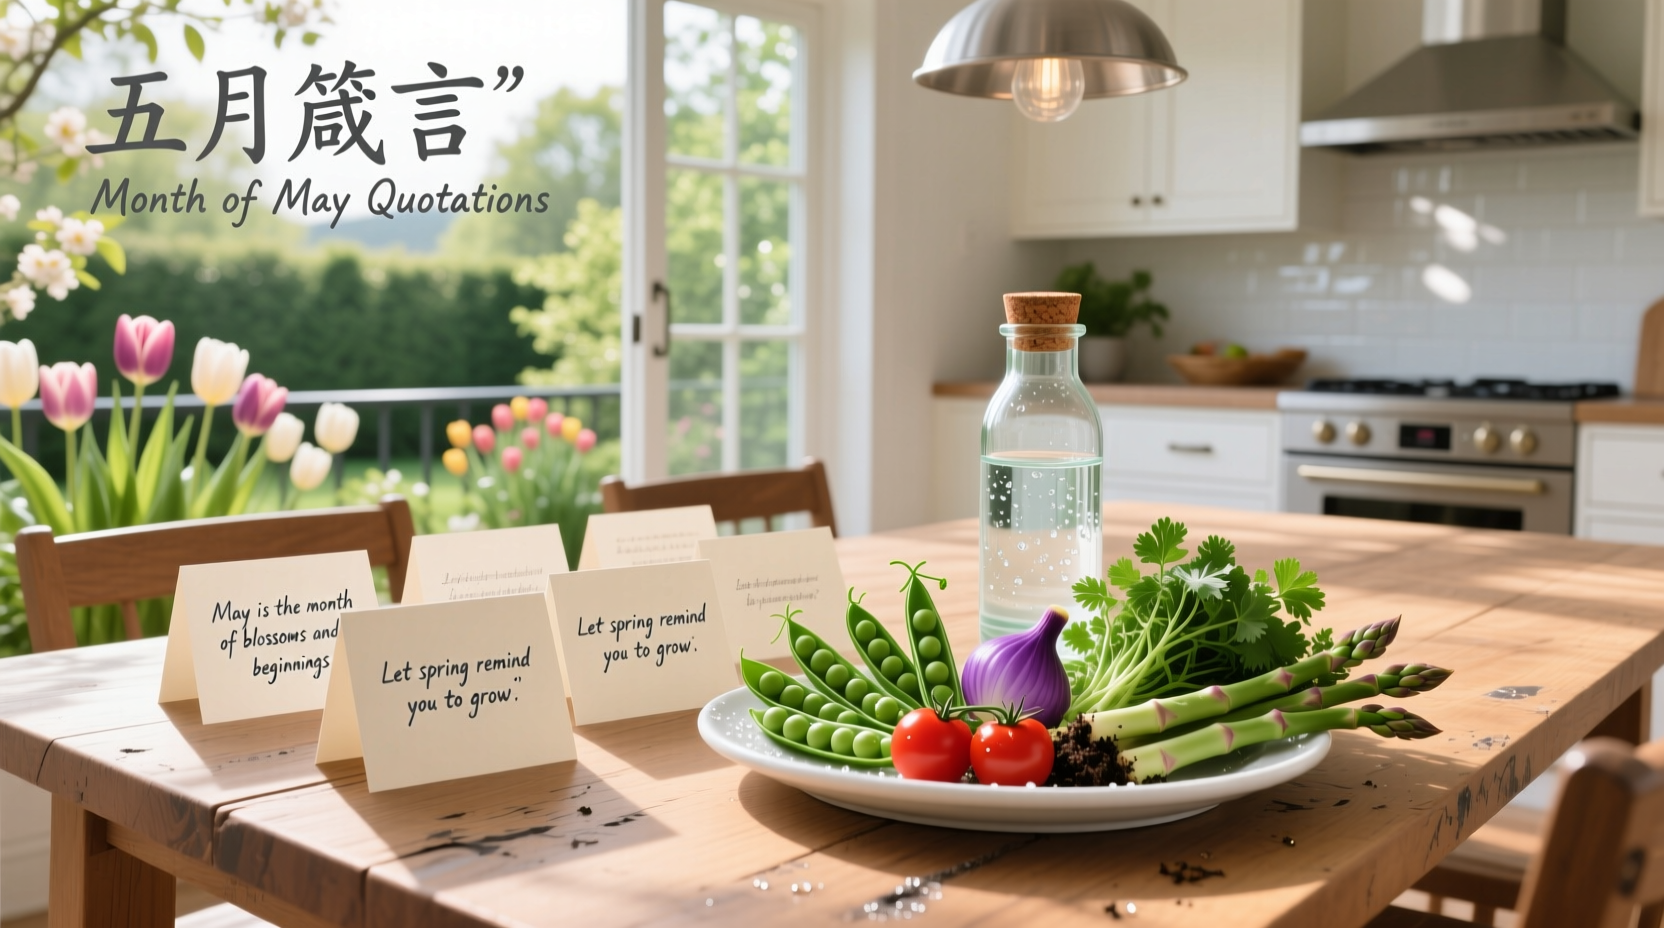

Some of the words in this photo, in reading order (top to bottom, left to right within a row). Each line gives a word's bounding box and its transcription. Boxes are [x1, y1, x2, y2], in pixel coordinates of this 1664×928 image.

[212, 600, 251, 630] May
[257, 602, 270, 618] is
[274, 595, 301, 616] the
[306, 588, 353, 613] month
[578, 616, 605, 637] Let
[609, 614, 654, 643] spring
[659, 602, 707, 627] remind
[220, 629, 238, 659] of
[243, 626, 307, 648] blossoms
[312, 617, 340, 640] and
[603, 649, 629, 674] you
[633, 641, 651, 659] to
[252, 655, 331, 685] beginnings
[381, 660, 413, 684] Let
[418, 658, 469, 690] spring
[476, 645, 531, 673] remind
[407, 699, 438, 728] you
[444, 689, 463, 709] to
